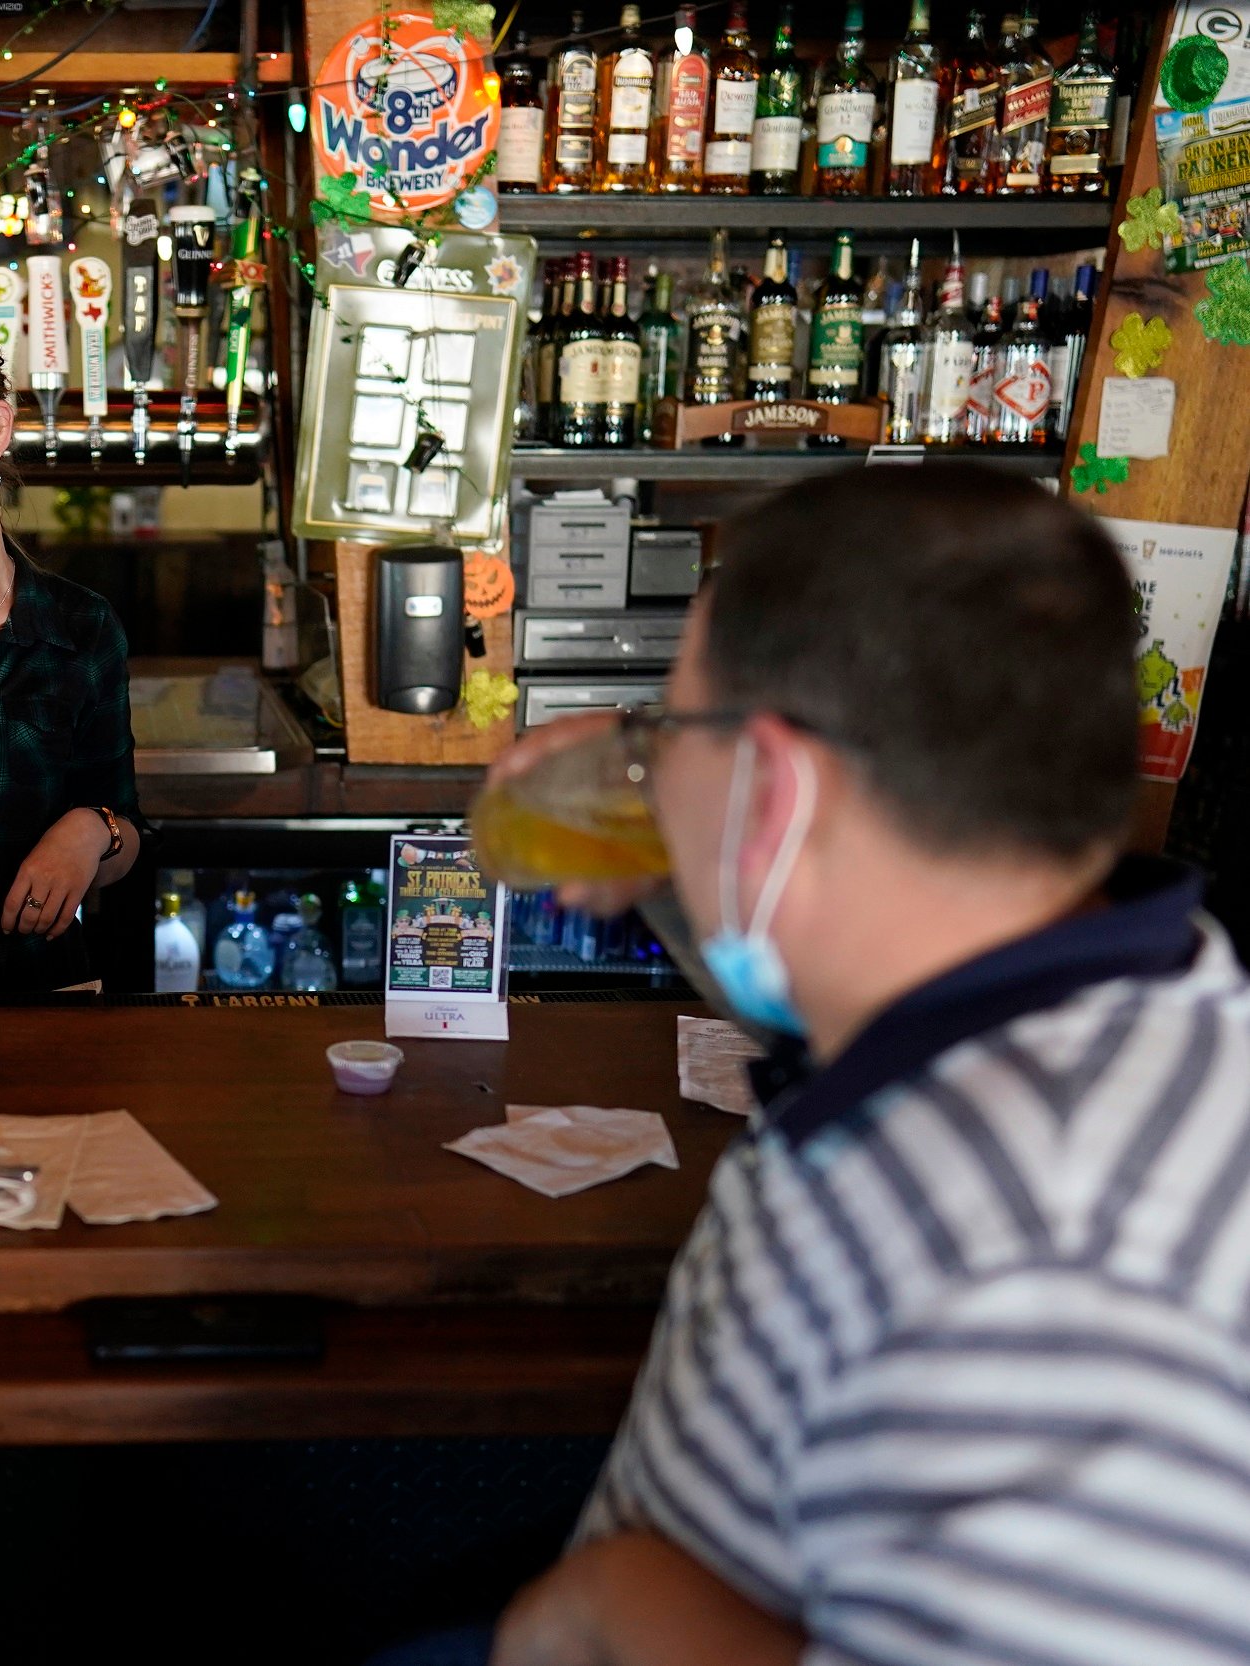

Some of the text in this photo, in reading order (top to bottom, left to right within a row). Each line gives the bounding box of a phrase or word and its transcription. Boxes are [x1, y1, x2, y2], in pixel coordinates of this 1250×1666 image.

[1008, 98, 1025, 111] RED
[1026, 90, 1050, 104] LABEL
[321, 99, 489, 171] Wonder
[1185, 139, 1227, 158] GREEN
[366, 171, 445, 191] BREWERY
[377, 259, 474, 292] GNNESS
[40, 273, 57, 369] SMITHWICKS
[745, 405, 821, 427] JAMESON
[426, 871, 481, 890] PATRICK'S
[424, 1012, 465, 1020] ULTRA
